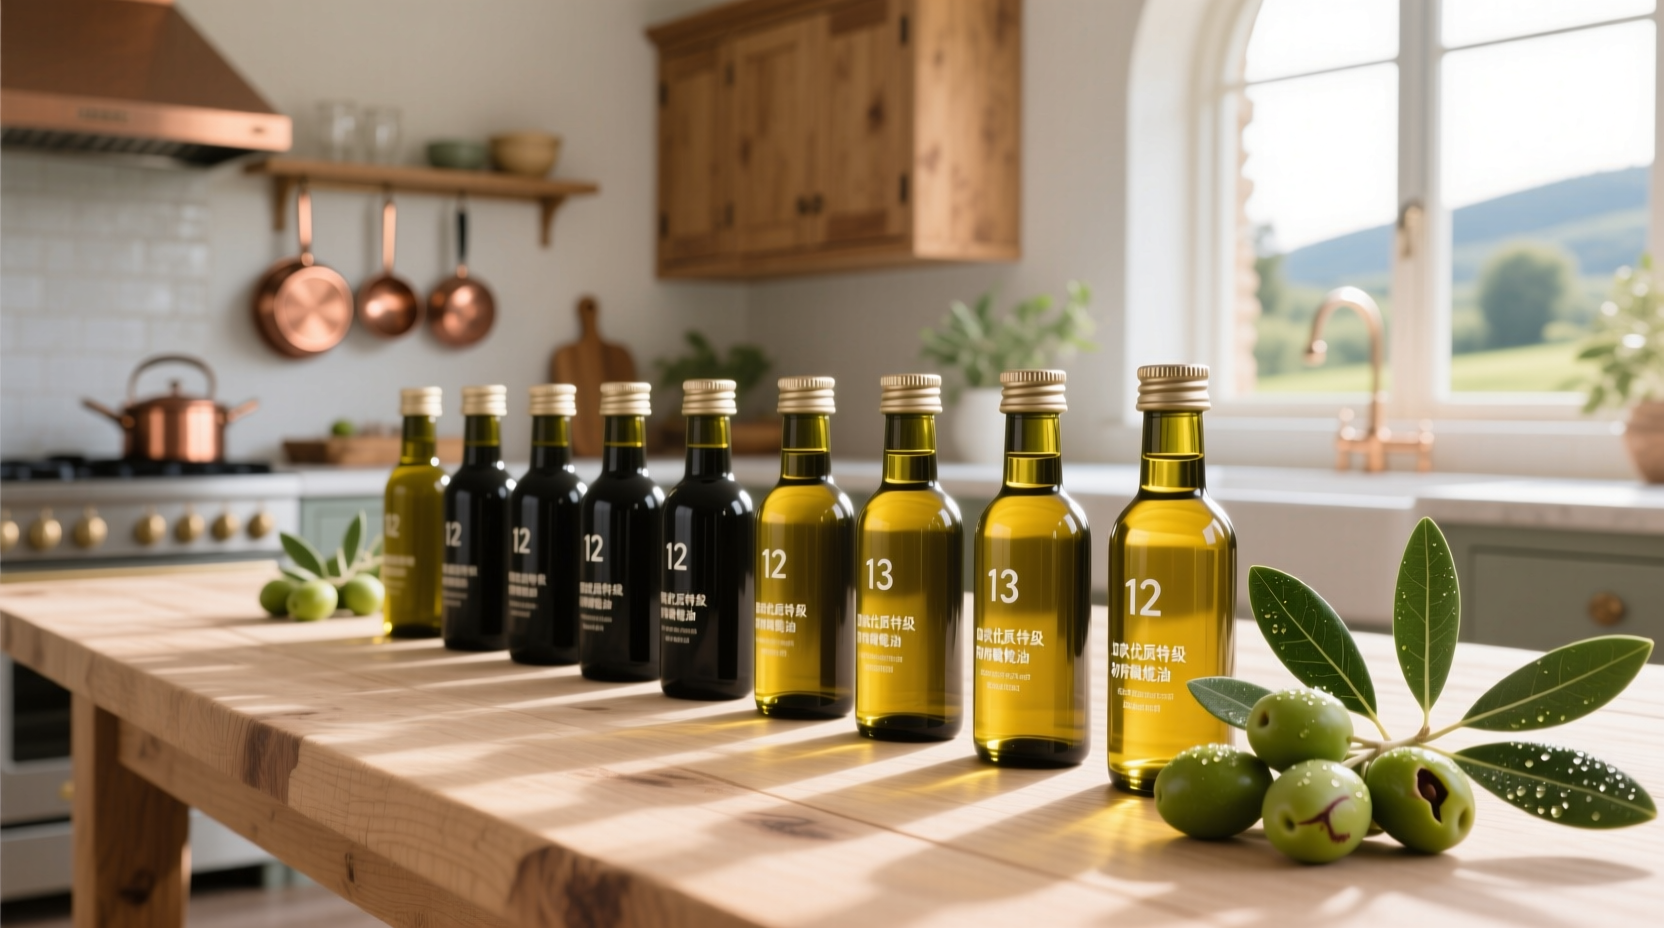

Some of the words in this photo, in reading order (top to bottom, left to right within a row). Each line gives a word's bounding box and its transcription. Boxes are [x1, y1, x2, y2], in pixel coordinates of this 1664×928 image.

[445, 521, 462, 547] 12
[512, 526, 531, 555] 12
[584, 533, 604, 563] 12
[666, 542, 688, 571] 12
[762, 548, 787, 579] 12
[866, 558, 894, 591] 13
[988, 568, 1019, 604] 13
[1125, 578, 1162, 617] 12
